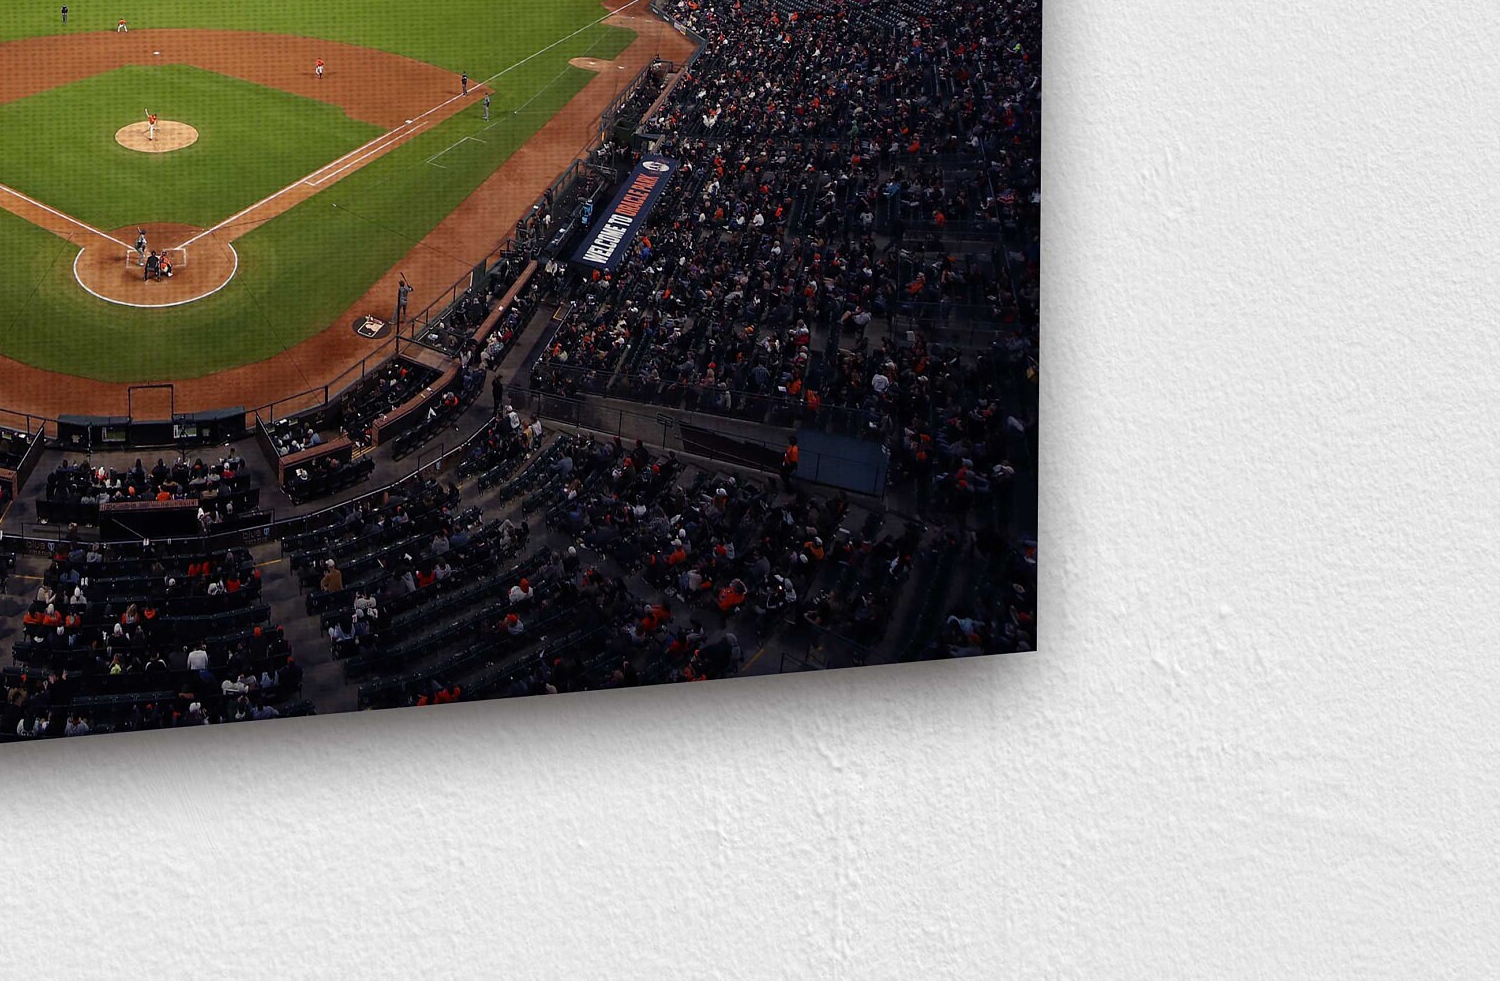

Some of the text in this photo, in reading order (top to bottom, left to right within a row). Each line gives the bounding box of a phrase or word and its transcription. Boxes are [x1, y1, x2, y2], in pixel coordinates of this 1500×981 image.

[582, 172, 660, 264] WELCOME TO ORACLE PARK
